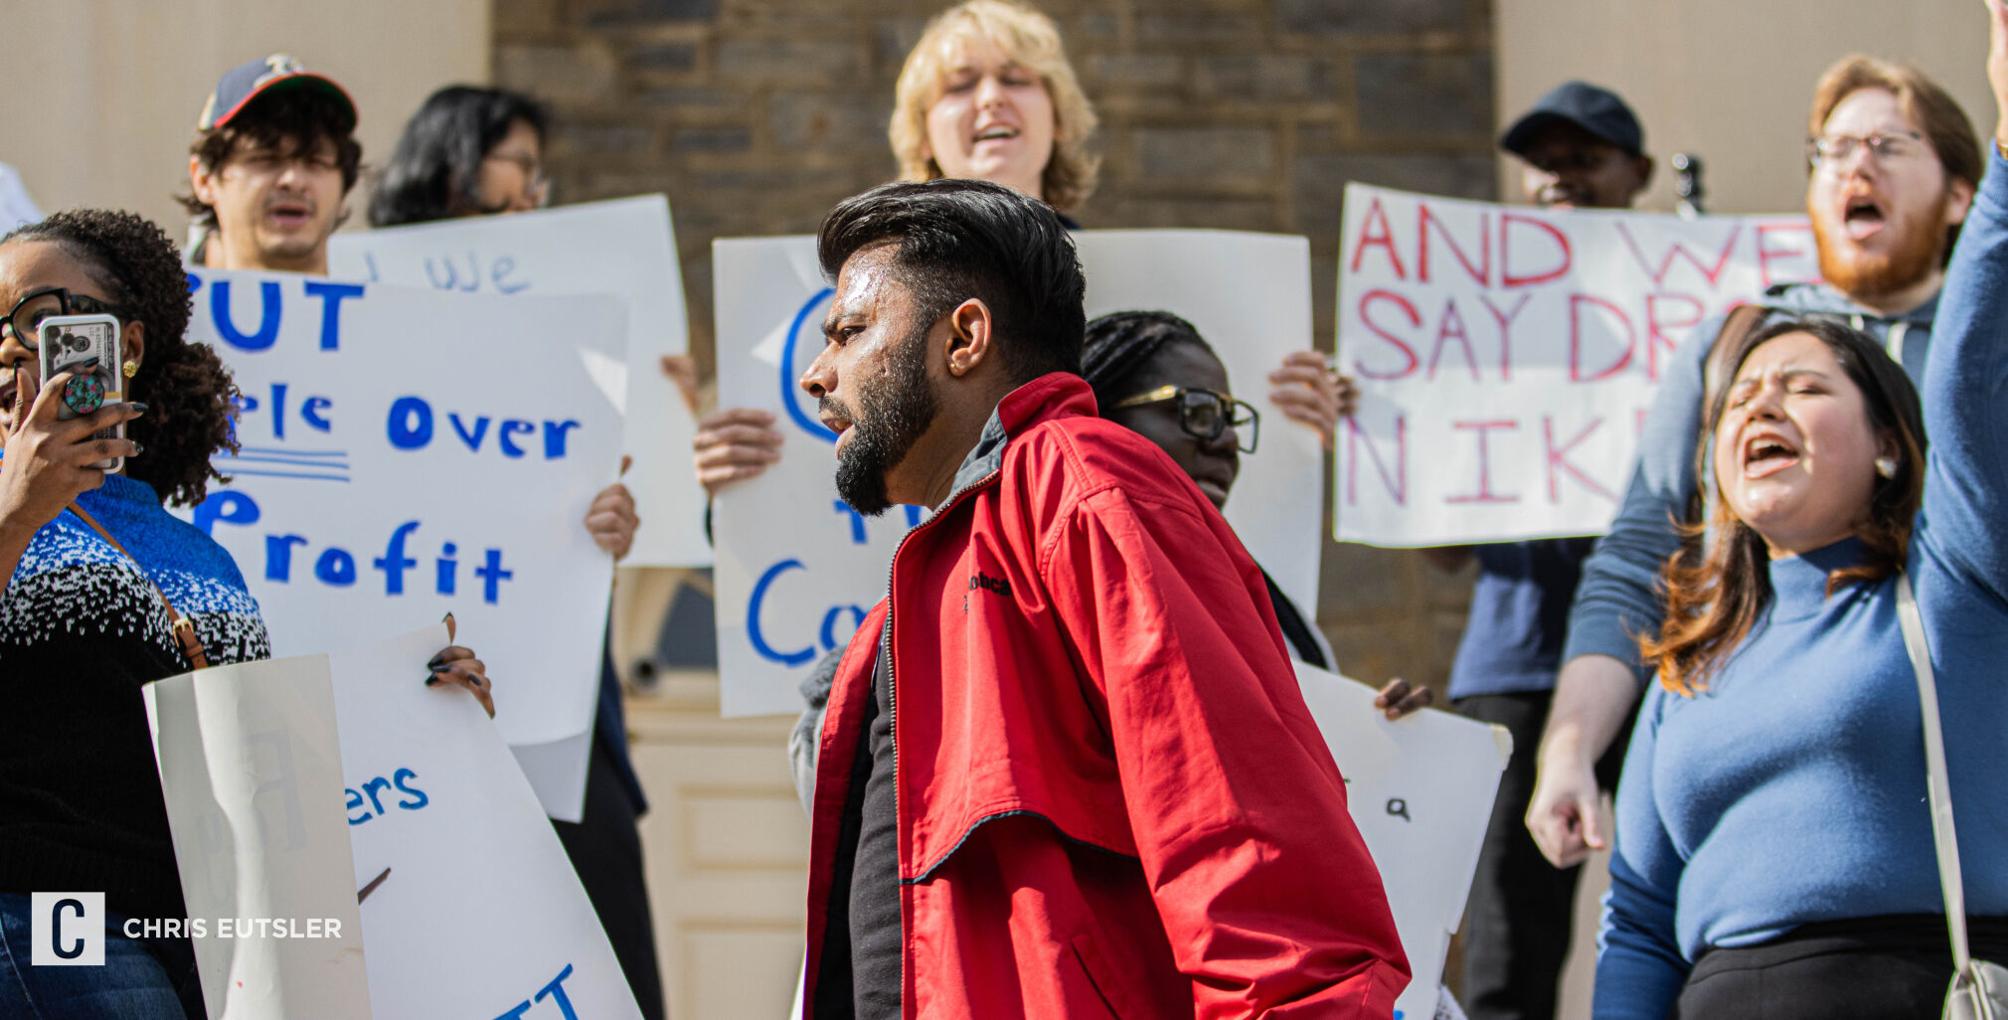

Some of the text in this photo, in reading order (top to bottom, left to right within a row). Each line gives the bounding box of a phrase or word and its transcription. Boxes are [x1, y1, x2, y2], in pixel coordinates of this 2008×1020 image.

[1350, 196, 1573, 288] AND
[1354, 289, 1748, 385] SAY DR
[387, 395, 582, 461] Over
[1341, 408, 1649, 506] NIK
[193, 490, 513, 605] Profit
[345, 768, 429, 826] ers
